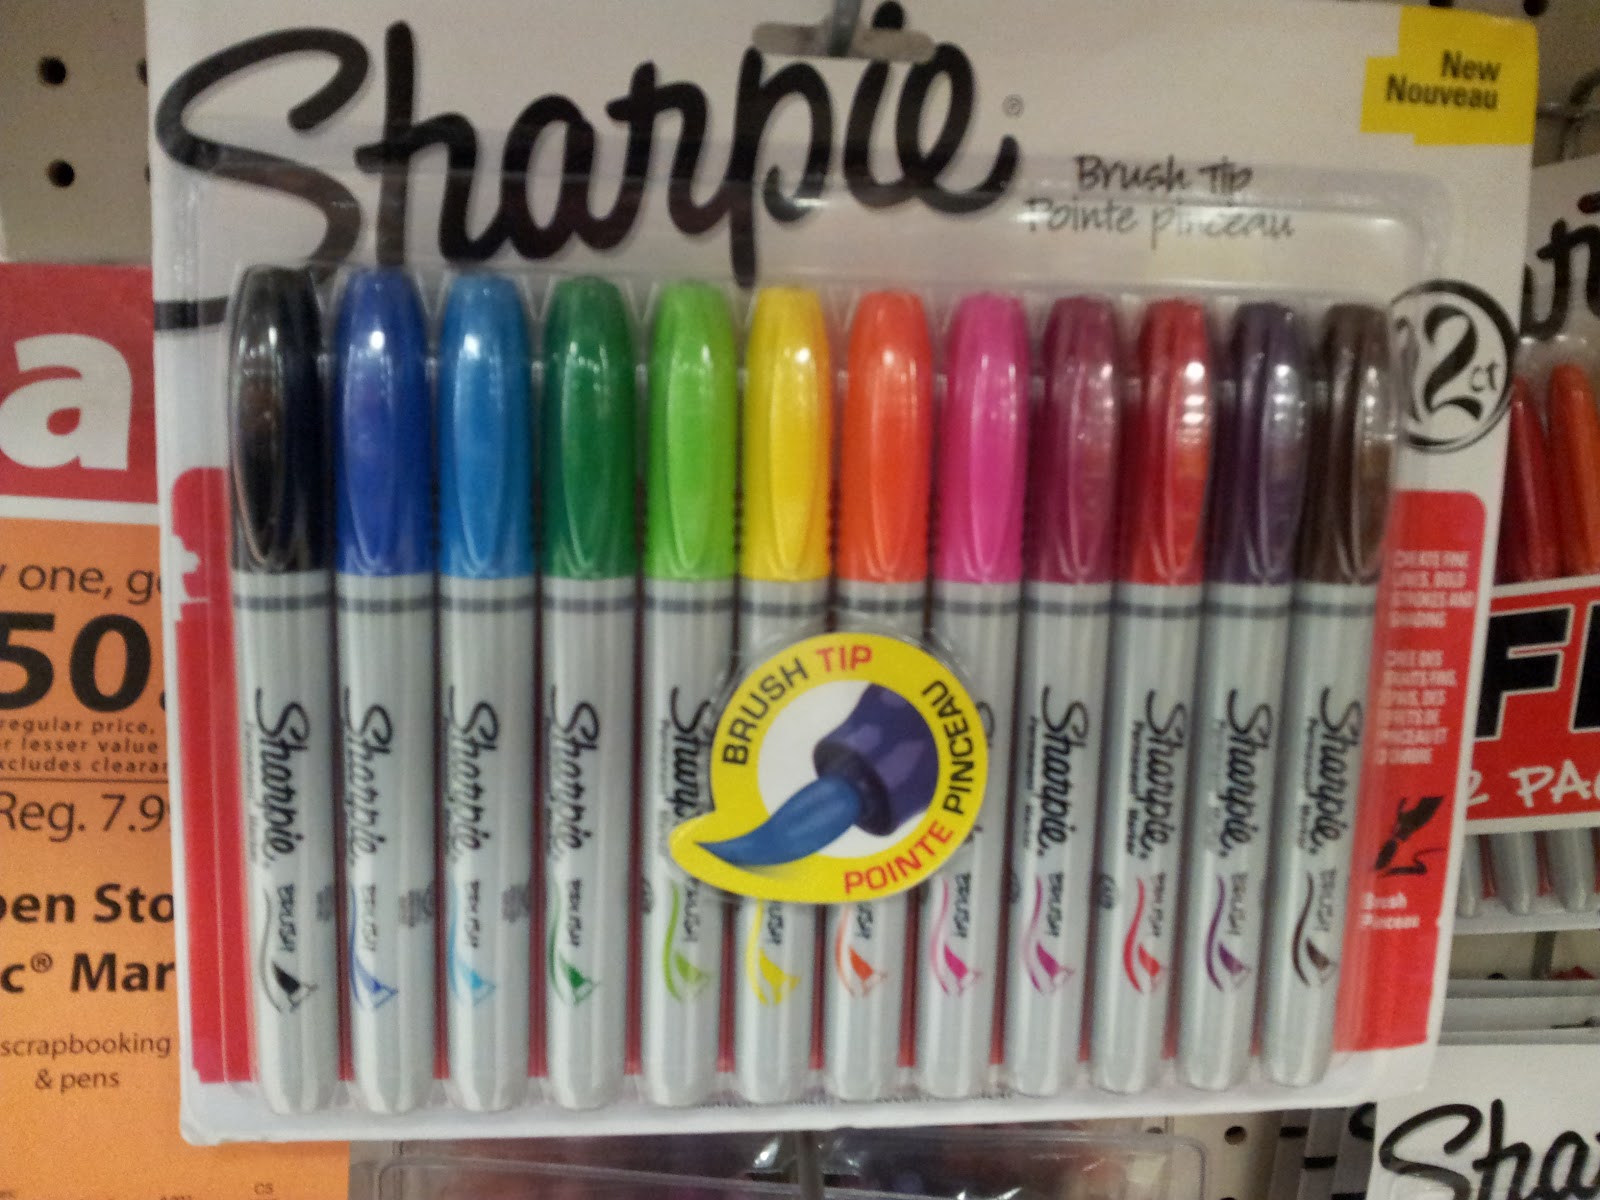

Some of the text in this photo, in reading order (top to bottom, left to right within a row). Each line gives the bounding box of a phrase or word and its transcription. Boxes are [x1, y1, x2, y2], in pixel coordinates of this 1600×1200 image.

[1384, 73, 1498, 110] Nouveau
[1441, 49, 1501, 81] New
[154, 2, 1020, 288] Sharpie
[1075, 154, 1192, 193] Brush
[18, 564, 162, 605] one, g
[0, 611, 166, 713] 50
[721, 645, 873, 766] BRUSH TIP
[21, 737, 88, 753] lesser
[98, 738, 159, 754] value
[255, 687, 311, 867] Sharpie
[344, 686, 393, 867] Sharpie
[449, 685, 500, 865] Sharpie
[551, 684, 600, 862] Sharpie
[844, 679, 976, 894] POINTE PINCEAU
[1037, 685, 1089, 857] Sharpie
[1139, 688, 1188, 860] Sharpie
[1218, 687, 1273, 858] Sharpie
[1310, 686, 1363, 855] Sharpie
[1508, 759, 1600, 808] PA
[101, 793, 171, 833] 7.9
[0, 893, 76, 923] en
[70, 952, 174, 993] Mar
[1, 1032, 171, 1059] scrapbooking
[34, 1068, 120, 1094] & pens
[1379, 1098, 1600, 1200] Sha
